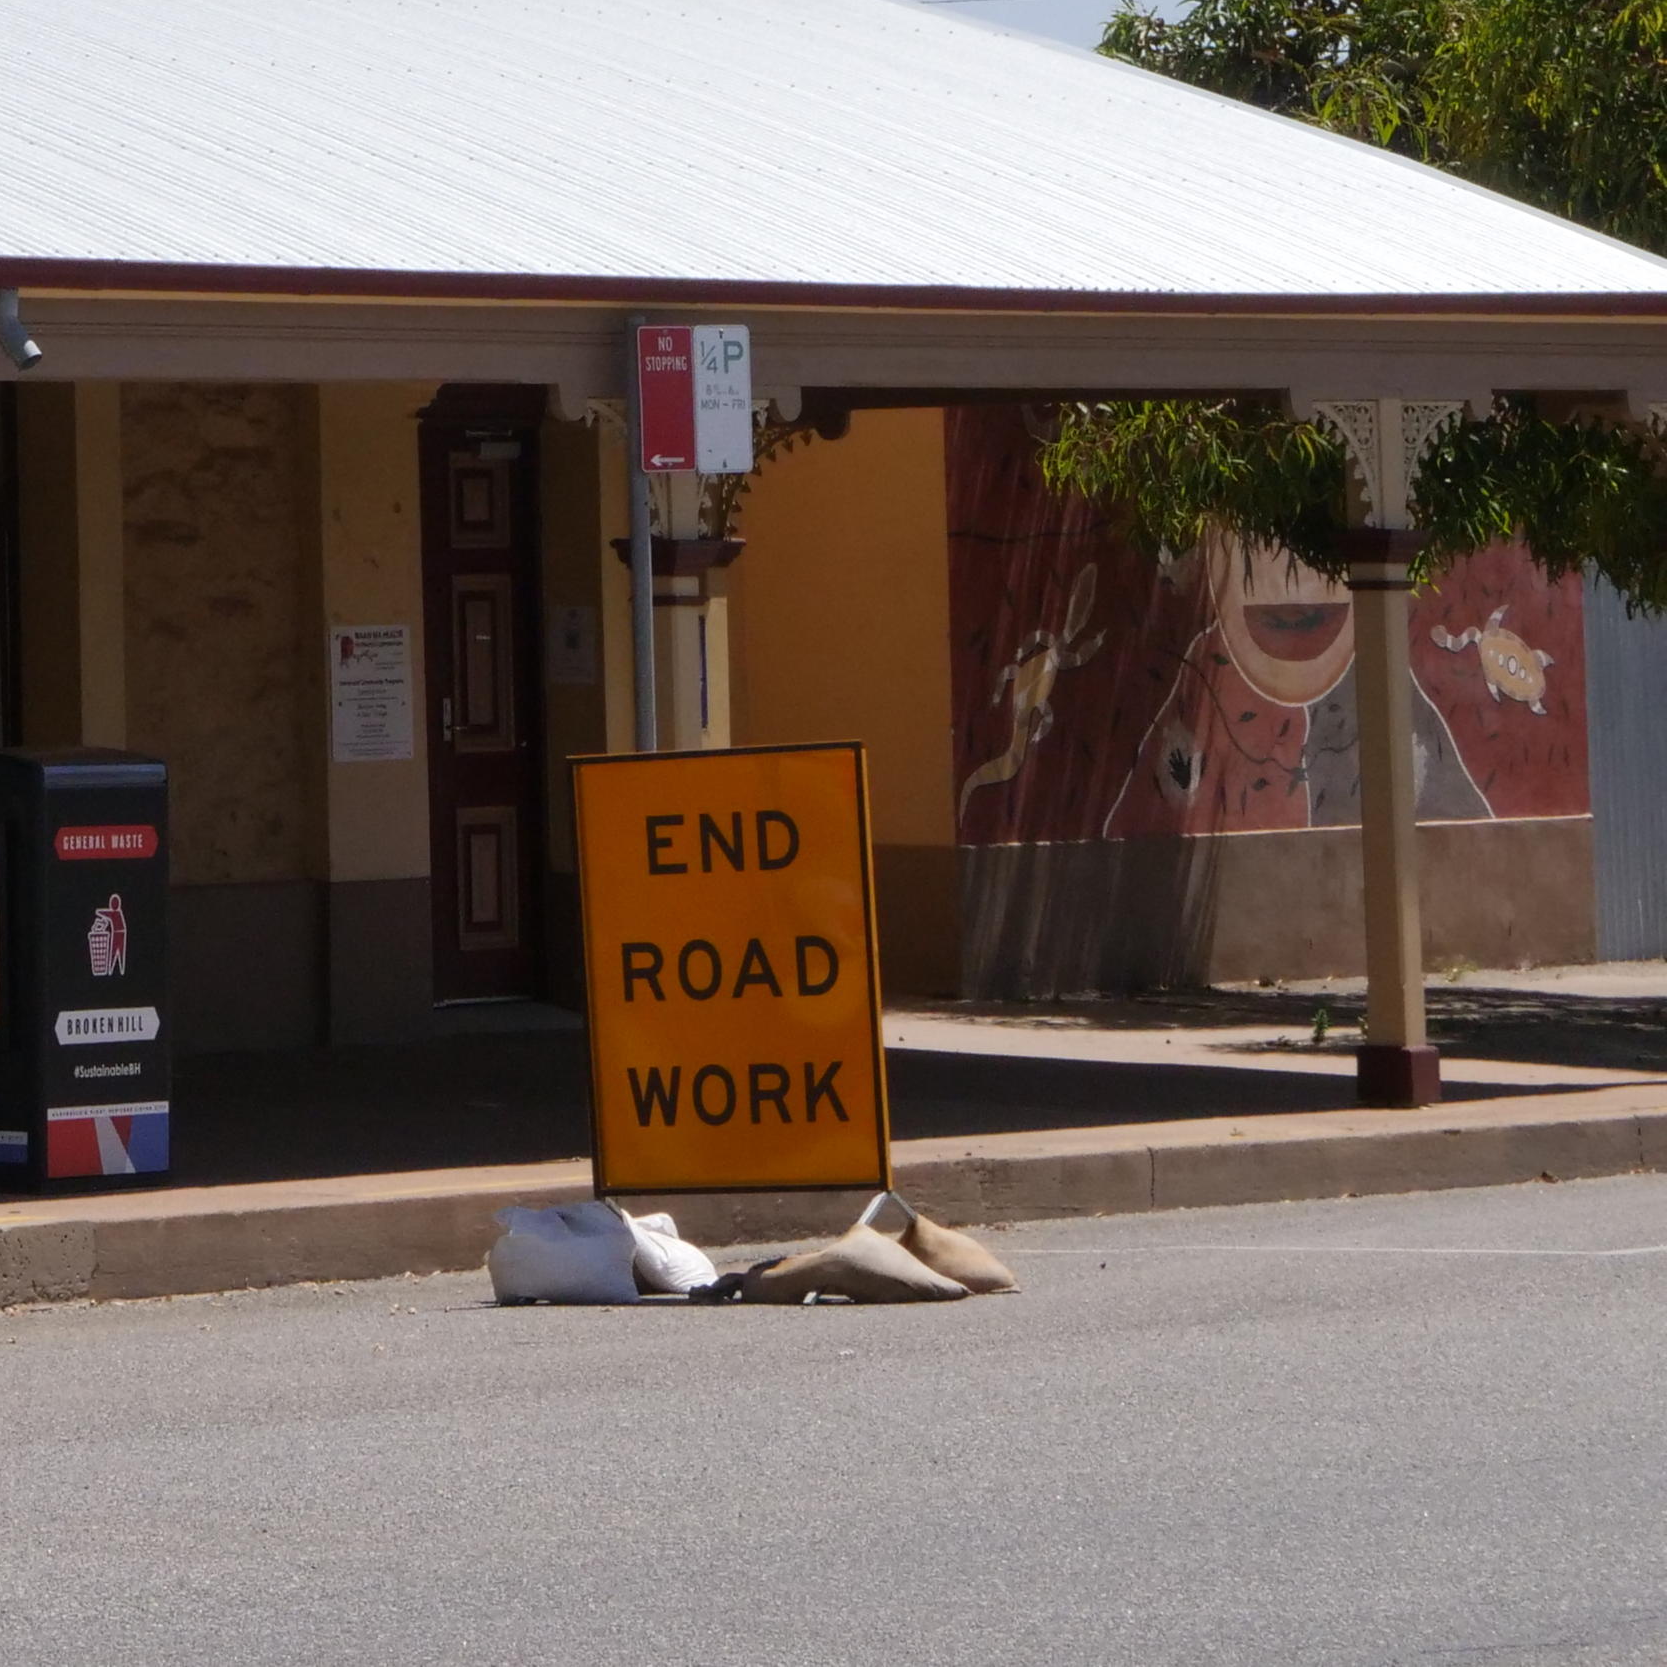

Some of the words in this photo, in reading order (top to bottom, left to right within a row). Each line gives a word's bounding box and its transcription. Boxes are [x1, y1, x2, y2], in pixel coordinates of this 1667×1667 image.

[657, 336, 673, 352] NO
[645, 356, 688, 372] STOPPING
[700, 398, 720, 410] MON
[732, 398, 746, 410] FRI
[63, 835, 105, 851] GENERAL
[111, 833, 143, 849] WASTE
[645, 810, 800, 875] END
[621, 935, 840, 1002] ROAD
[67, 1016, 114, 1036] BROKEN
[117, 1015, 144, 1033] HILL
[74, 1062, 141, 1079] #SustainableBH
[627, 1061, 850, 1127] WORK
